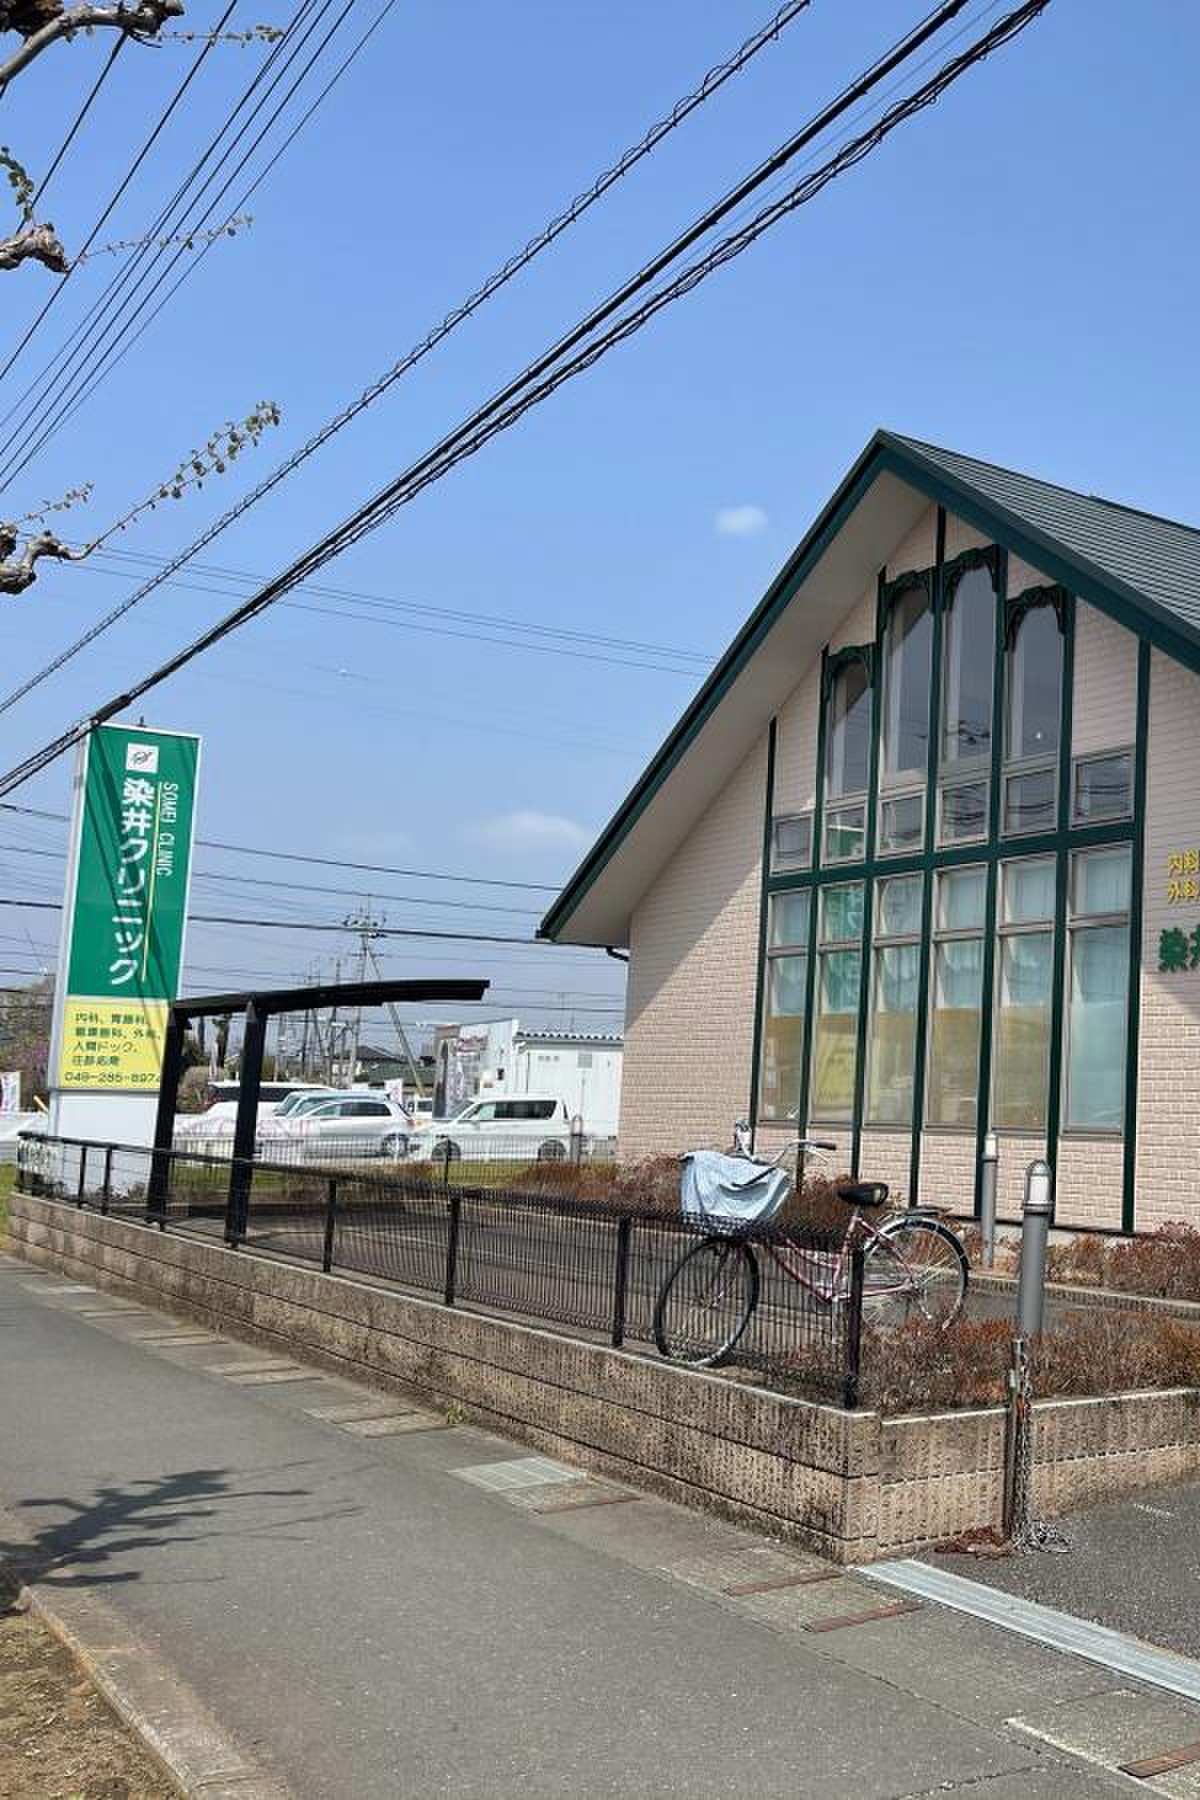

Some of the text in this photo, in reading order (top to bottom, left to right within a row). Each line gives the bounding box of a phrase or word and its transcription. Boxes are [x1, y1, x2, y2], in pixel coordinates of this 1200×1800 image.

[109, 777, 156, 985] 染井クリニック
[156, 783, 179, 877] SOMEI CLINIC
